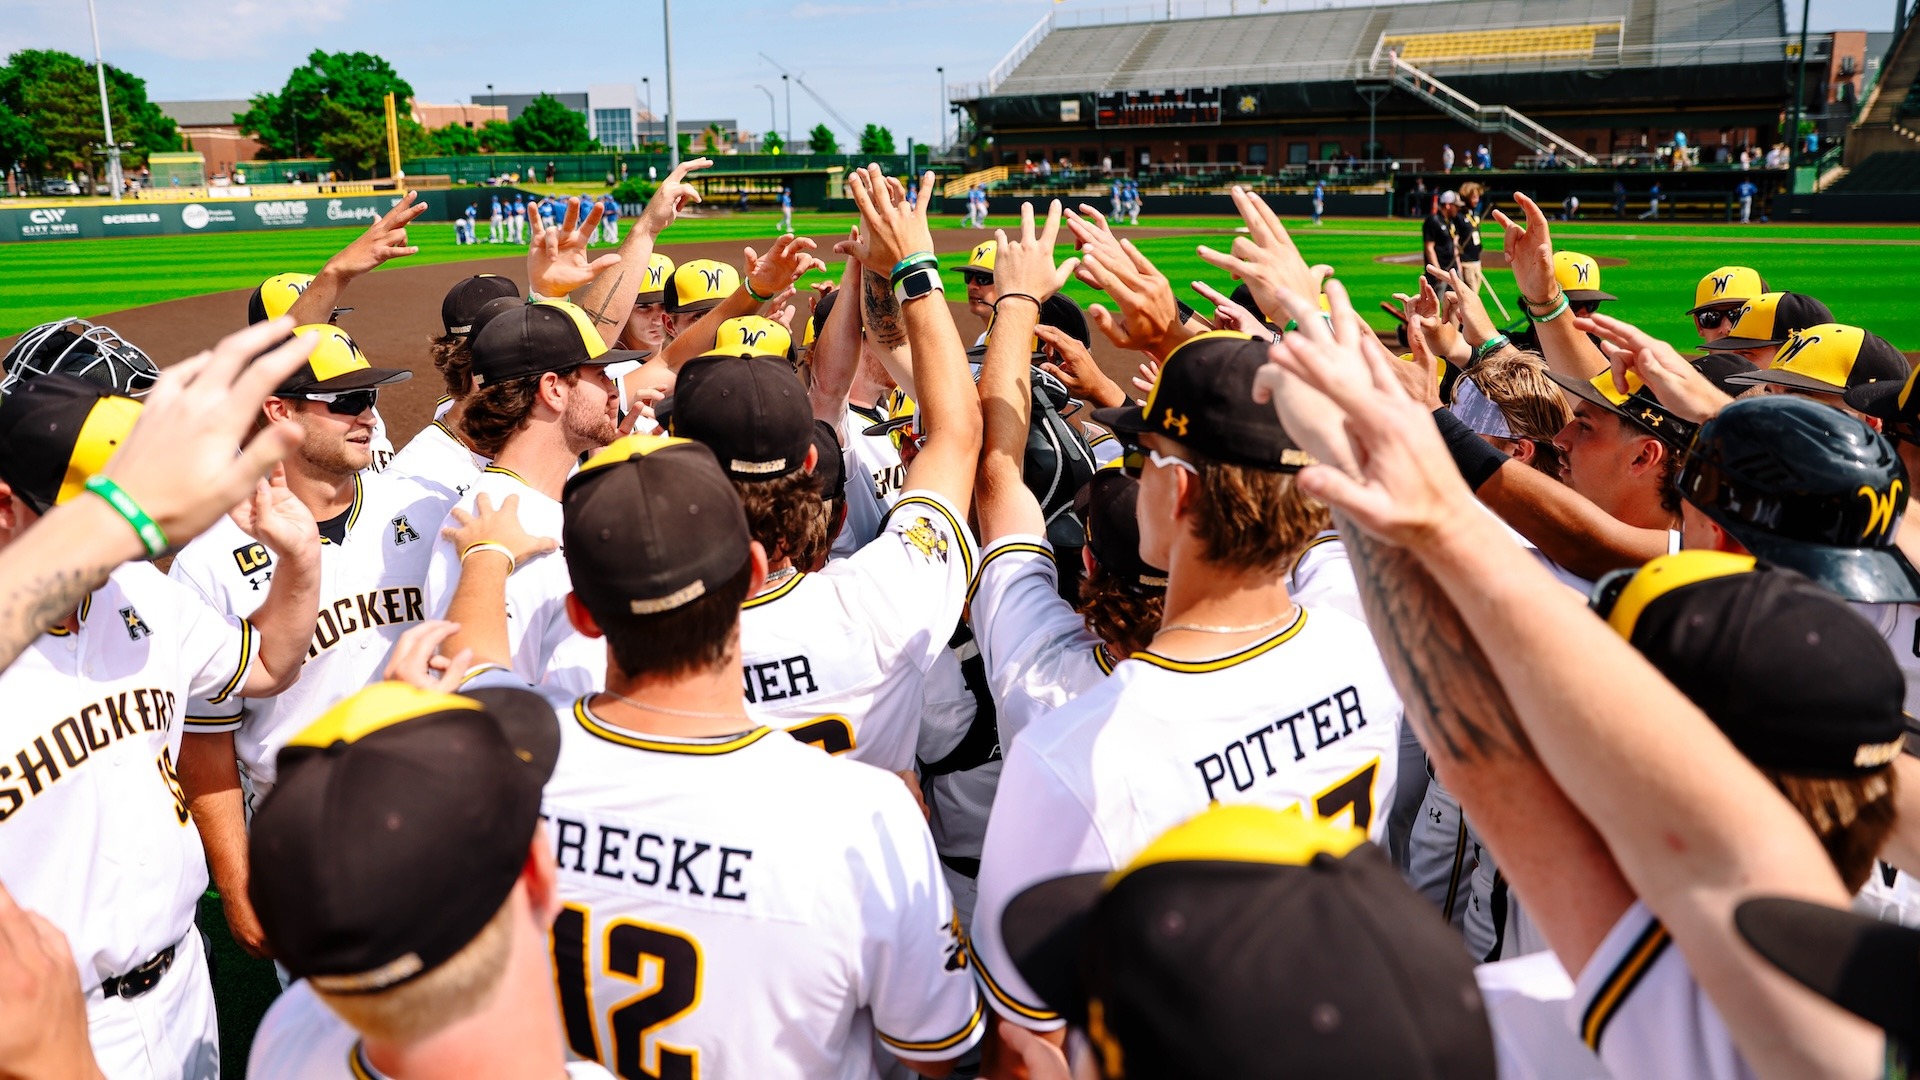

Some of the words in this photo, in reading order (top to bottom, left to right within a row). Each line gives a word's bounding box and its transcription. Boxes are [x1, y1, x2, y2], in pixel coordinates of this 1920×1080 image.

[102, 213, 160, 224] SCHEELS
[698, 268, 724, 292] W
[1571, 262, 1590, 284] W
[1710, 273, 1734, 296] W
[739, 326, 767, 348] W
[1775, 333, 1822, 363] W
[1857, 479, 1904, 539] W
[236, 544, 269, 573] LC
[1193, 685, 1368, 801] POTTER
[538, 813, 753, 902] RESKE
[547, 900, 706, 1080] 12
